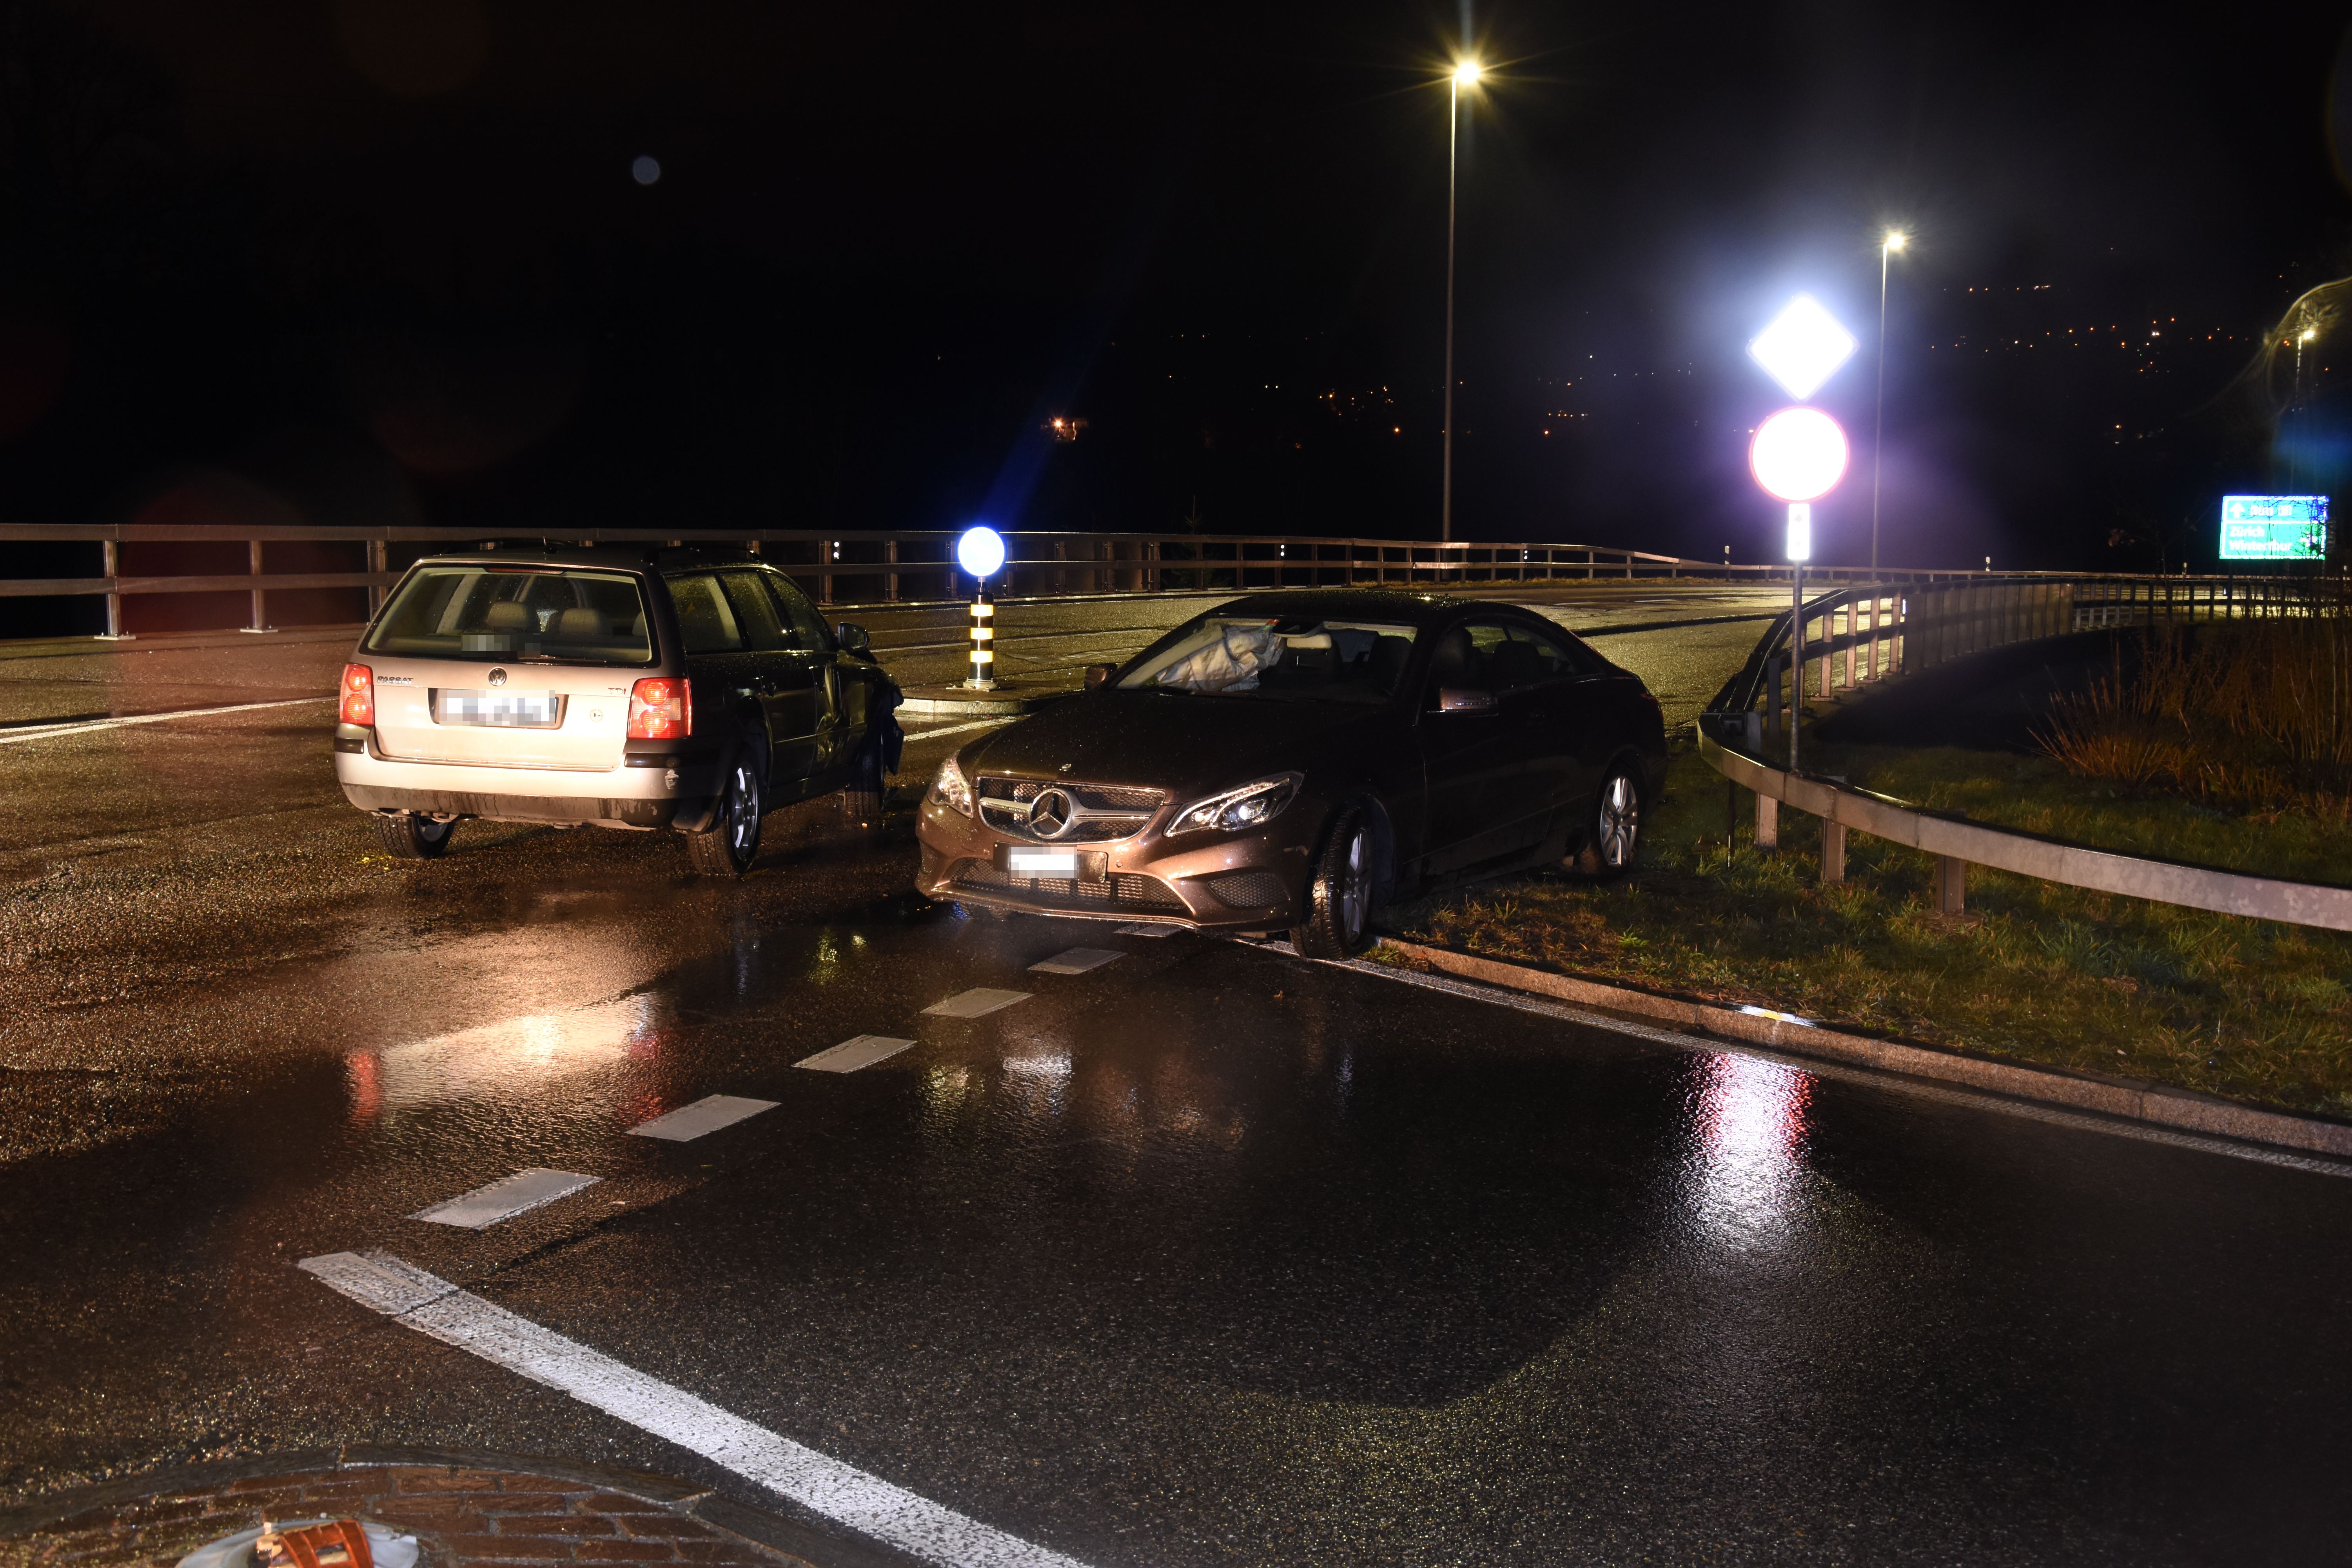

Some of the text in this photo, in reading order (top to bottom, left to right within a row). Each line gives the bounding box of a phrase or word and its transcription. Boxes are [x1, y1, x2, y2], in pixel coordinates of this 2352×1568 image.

[2229, 526, 2265, 536] Zürich
[2229, 540, 2292, 550] Winterthur
[377, 676, 414, 684] PASSAT
